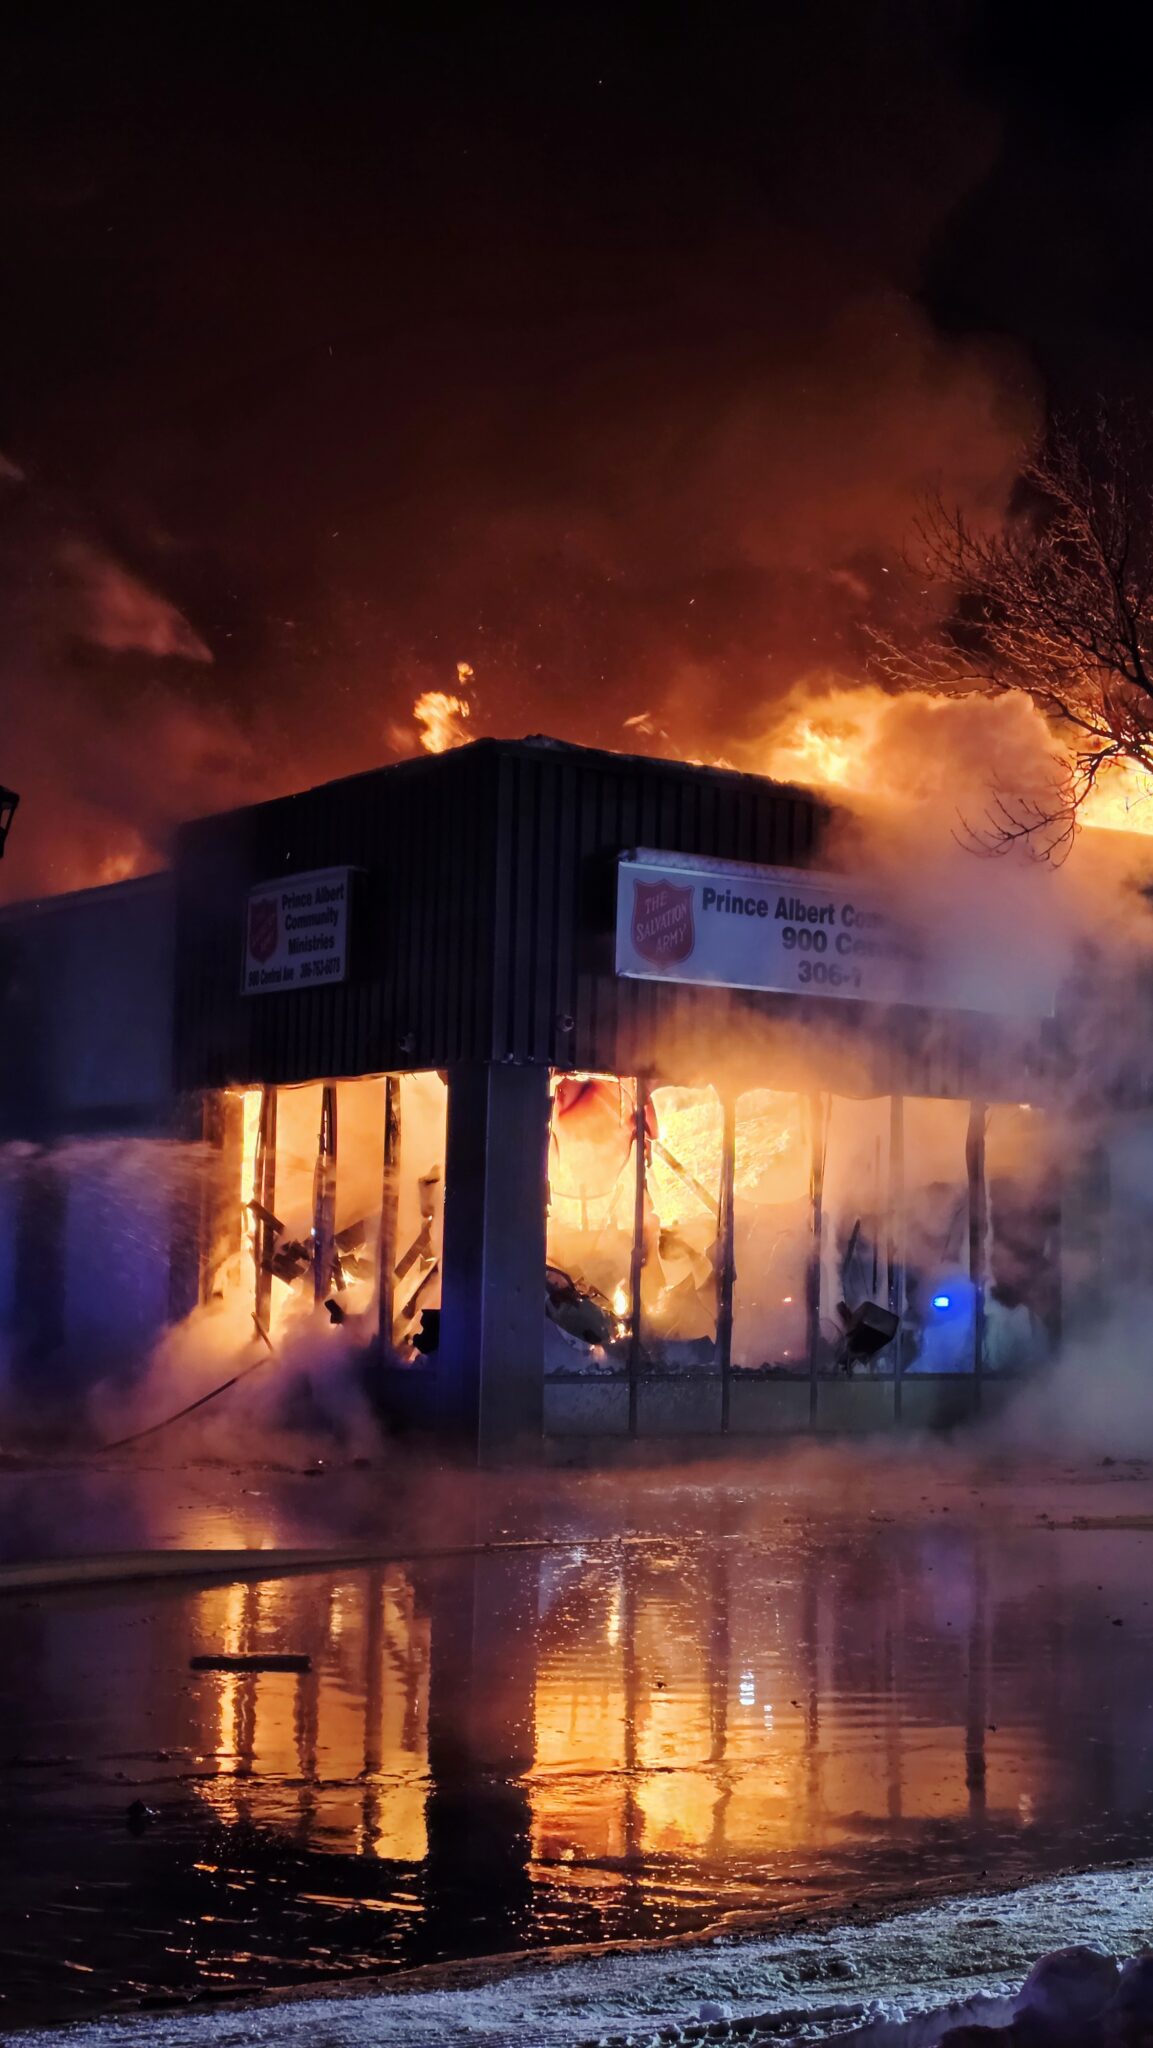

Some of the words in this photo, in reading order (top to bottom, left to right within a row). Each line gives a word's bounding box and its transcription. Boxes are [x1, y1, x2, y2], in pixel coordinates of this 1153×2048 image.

[282, 892, 312, 910] Prince
[315, 883, 345, 904] Albert
[644, 890, 668, 915] THE
[702, 887, 769, 918] Prince
[774, 896, 836, 925] Albert
[285, 906, 339, 930] Community
[636, 898, 687, 942] SALVATION
[287, 933, 335, 955] Ministries
[656, 923, 687, 954] ARMY
[782, 926, 828, 953] 900
